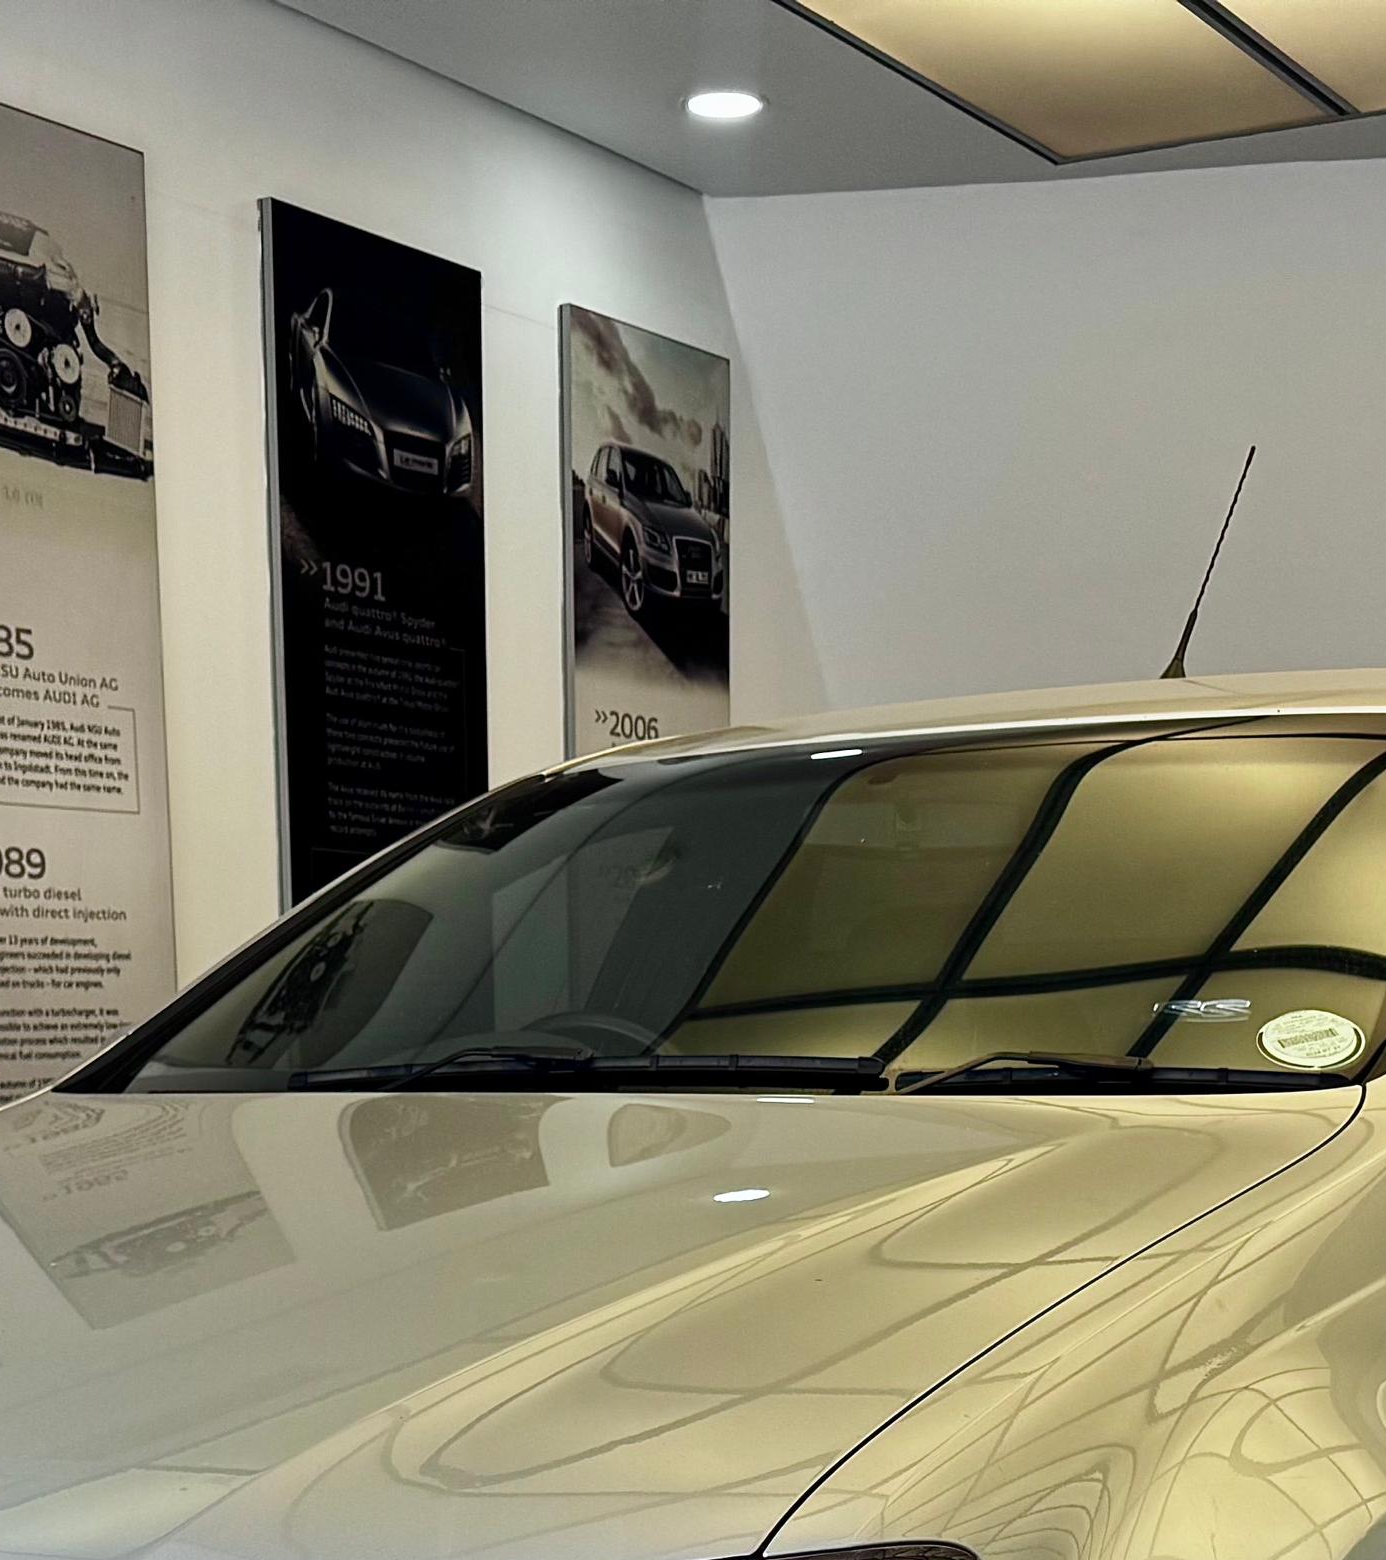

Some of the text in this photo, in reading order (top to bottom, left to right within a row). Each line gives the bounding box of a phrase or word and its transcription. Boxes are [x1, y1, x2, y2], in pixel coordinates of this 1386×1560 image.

[321, 561, 387, 603] 1991
[22, 666, 56, 684] Auto
[58, 671, 97, 689] Union
[99, 676, 119, 691] AG
[42, 688, 77, 706] AUDI
[80, 693, 100, 708] AG
[609, 710, 660, 741] 2006
[2, 886, 40, 900] turbo
[43, 887, 82, 901] diesel
[31, 905, 70, 919] direct
[72, 907, 127, 923] injection
